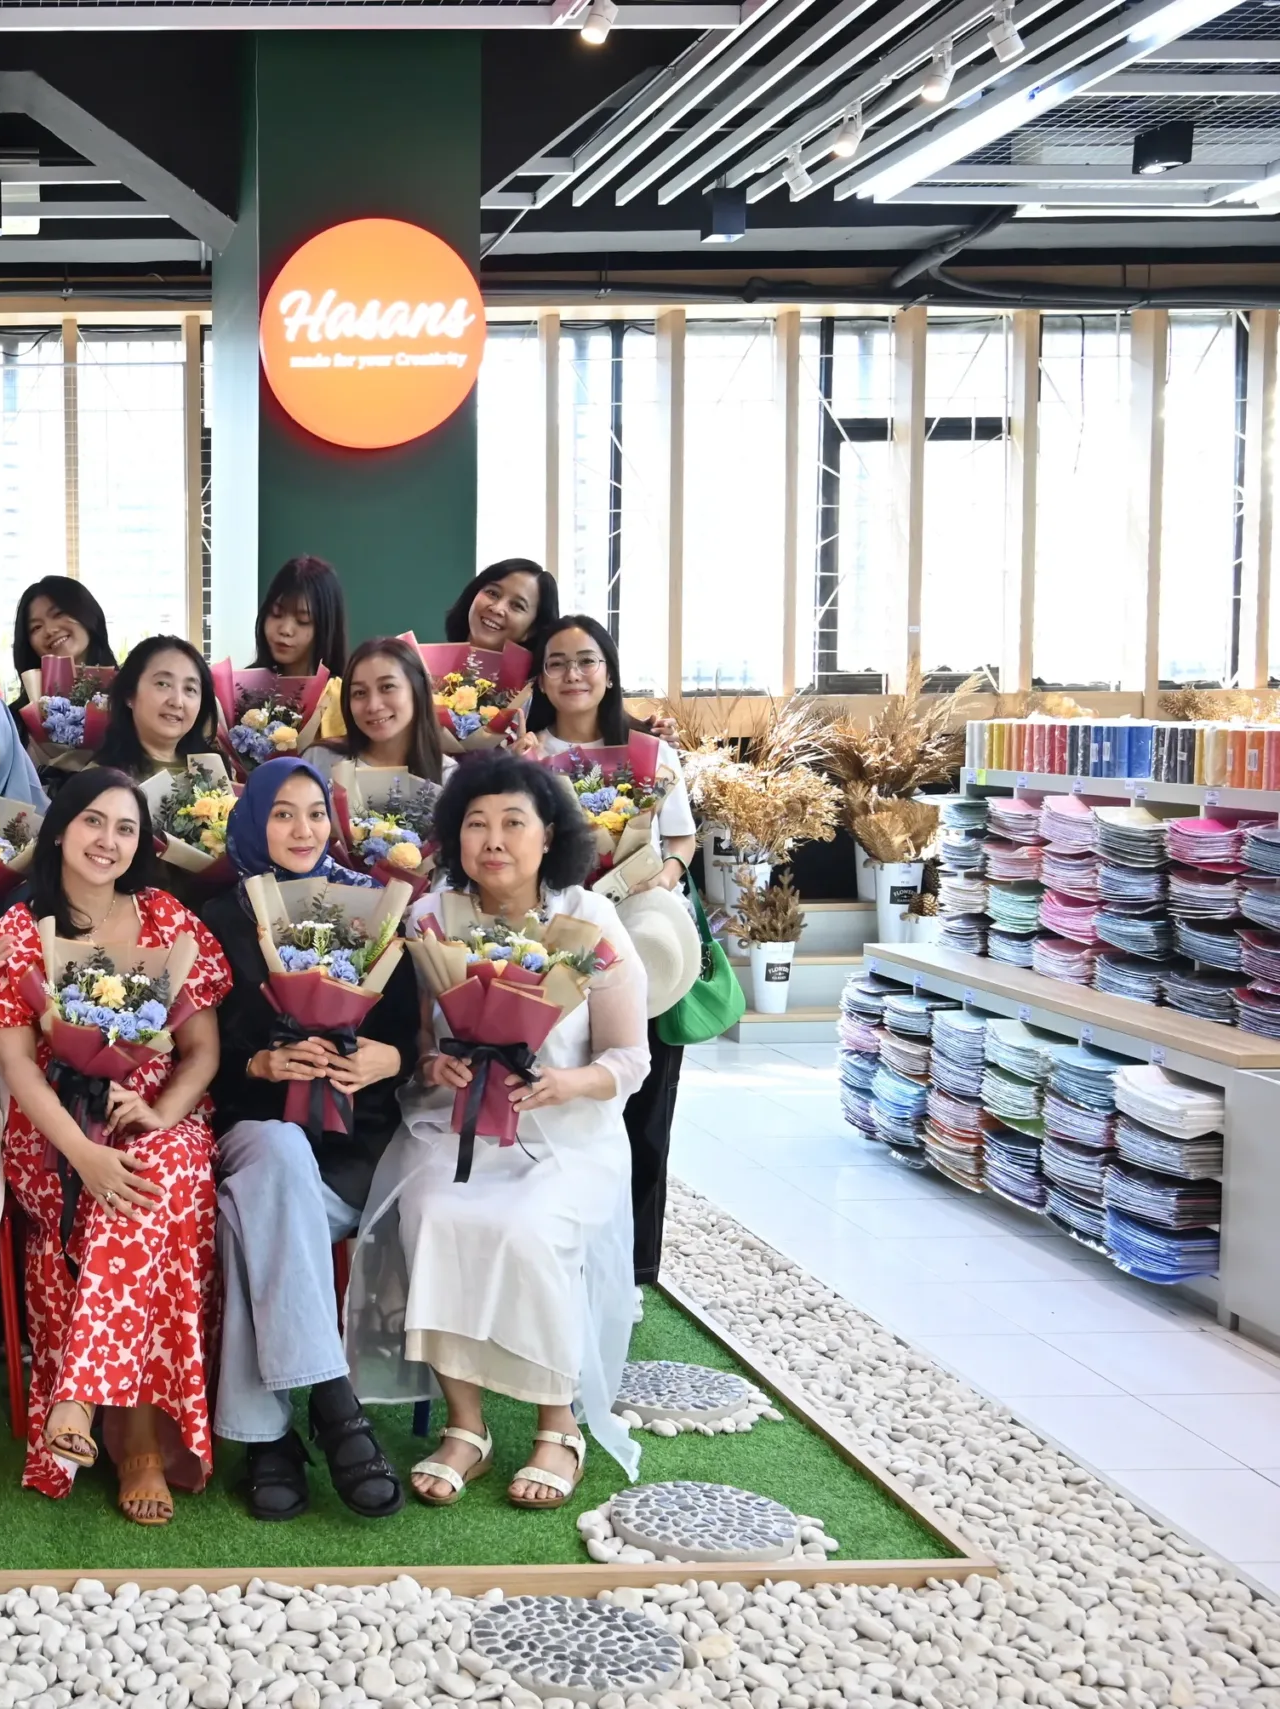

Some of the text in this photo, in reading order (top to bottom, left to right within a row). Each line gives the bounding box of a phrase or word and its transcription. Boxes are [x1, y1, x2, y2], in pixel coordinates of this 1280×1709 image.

[279, 288, 476, 342] Hasans
[290, 352, 468, 370] made for your Creativity
